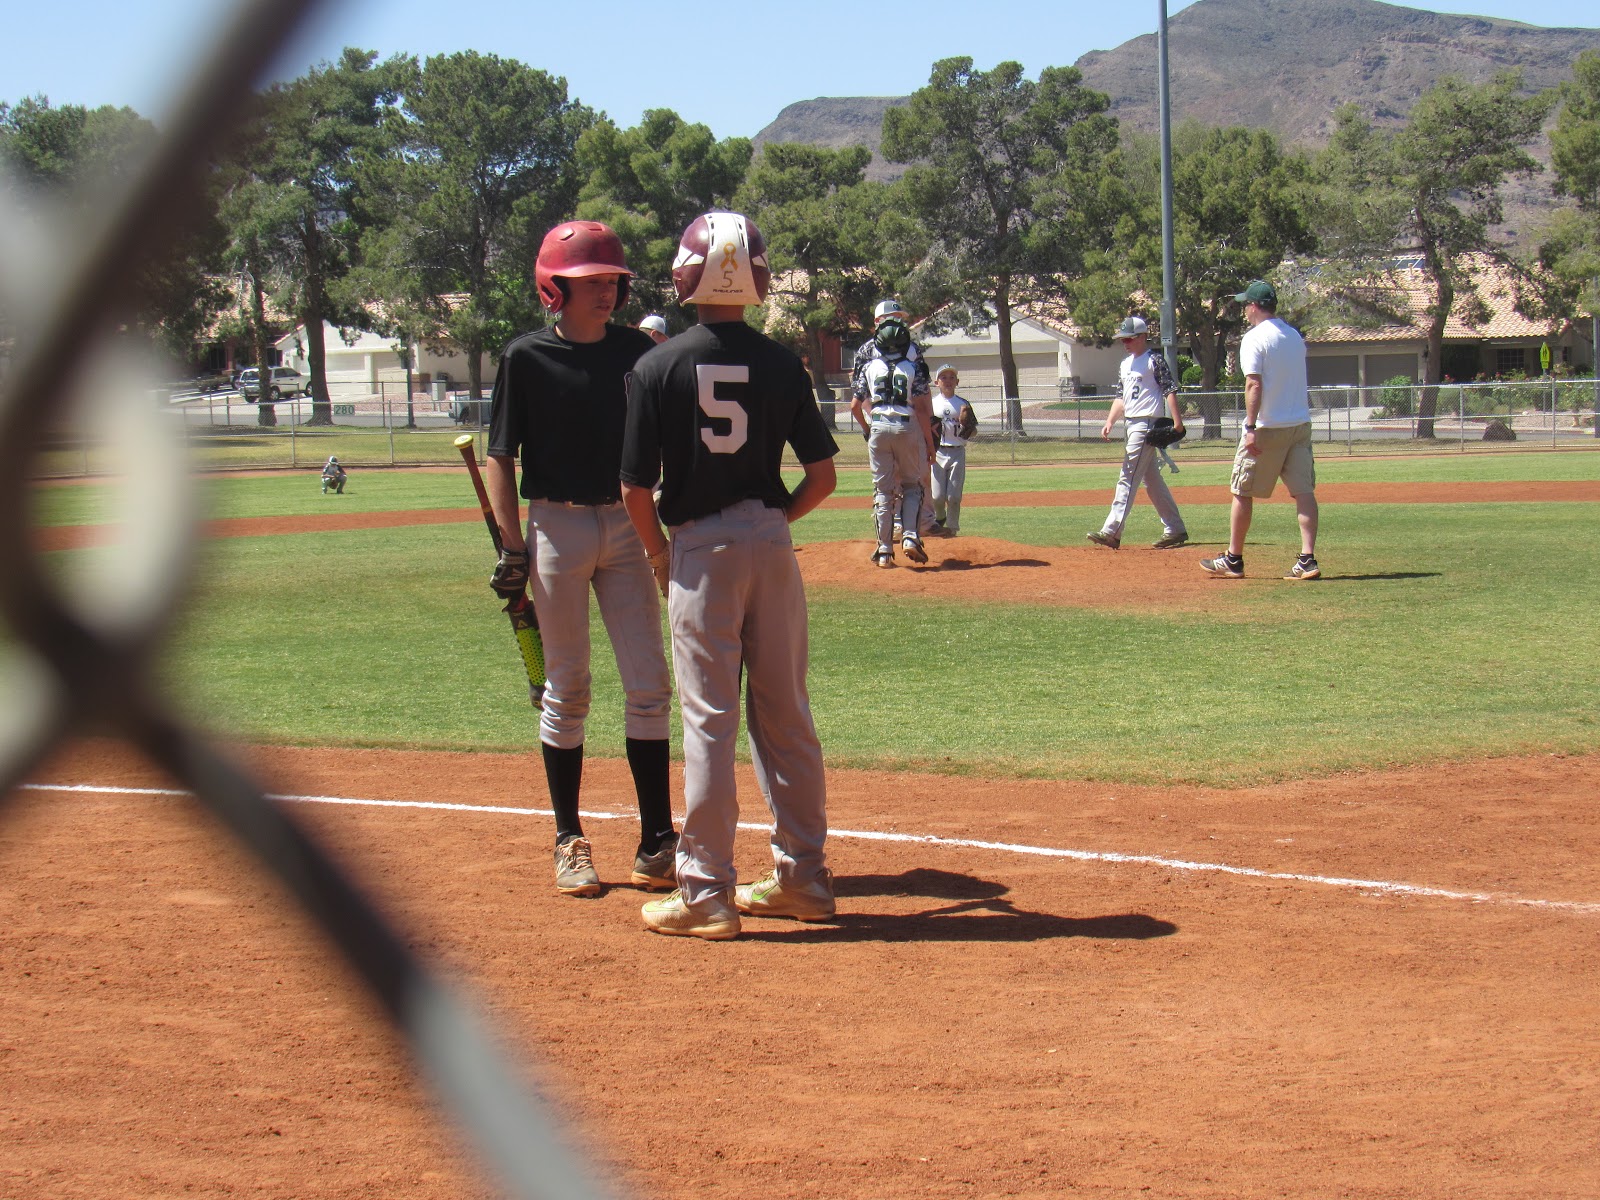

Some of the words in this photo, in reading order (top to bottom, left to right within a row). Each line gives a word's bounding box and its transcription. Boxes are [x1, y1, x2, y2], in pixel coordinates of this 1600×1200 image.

[721, 271, 733, 288] 5
[1131, 385, 1140, 400] 2
[335, 404, 355, 415] 280
[695, 364, 749, 454] 5
